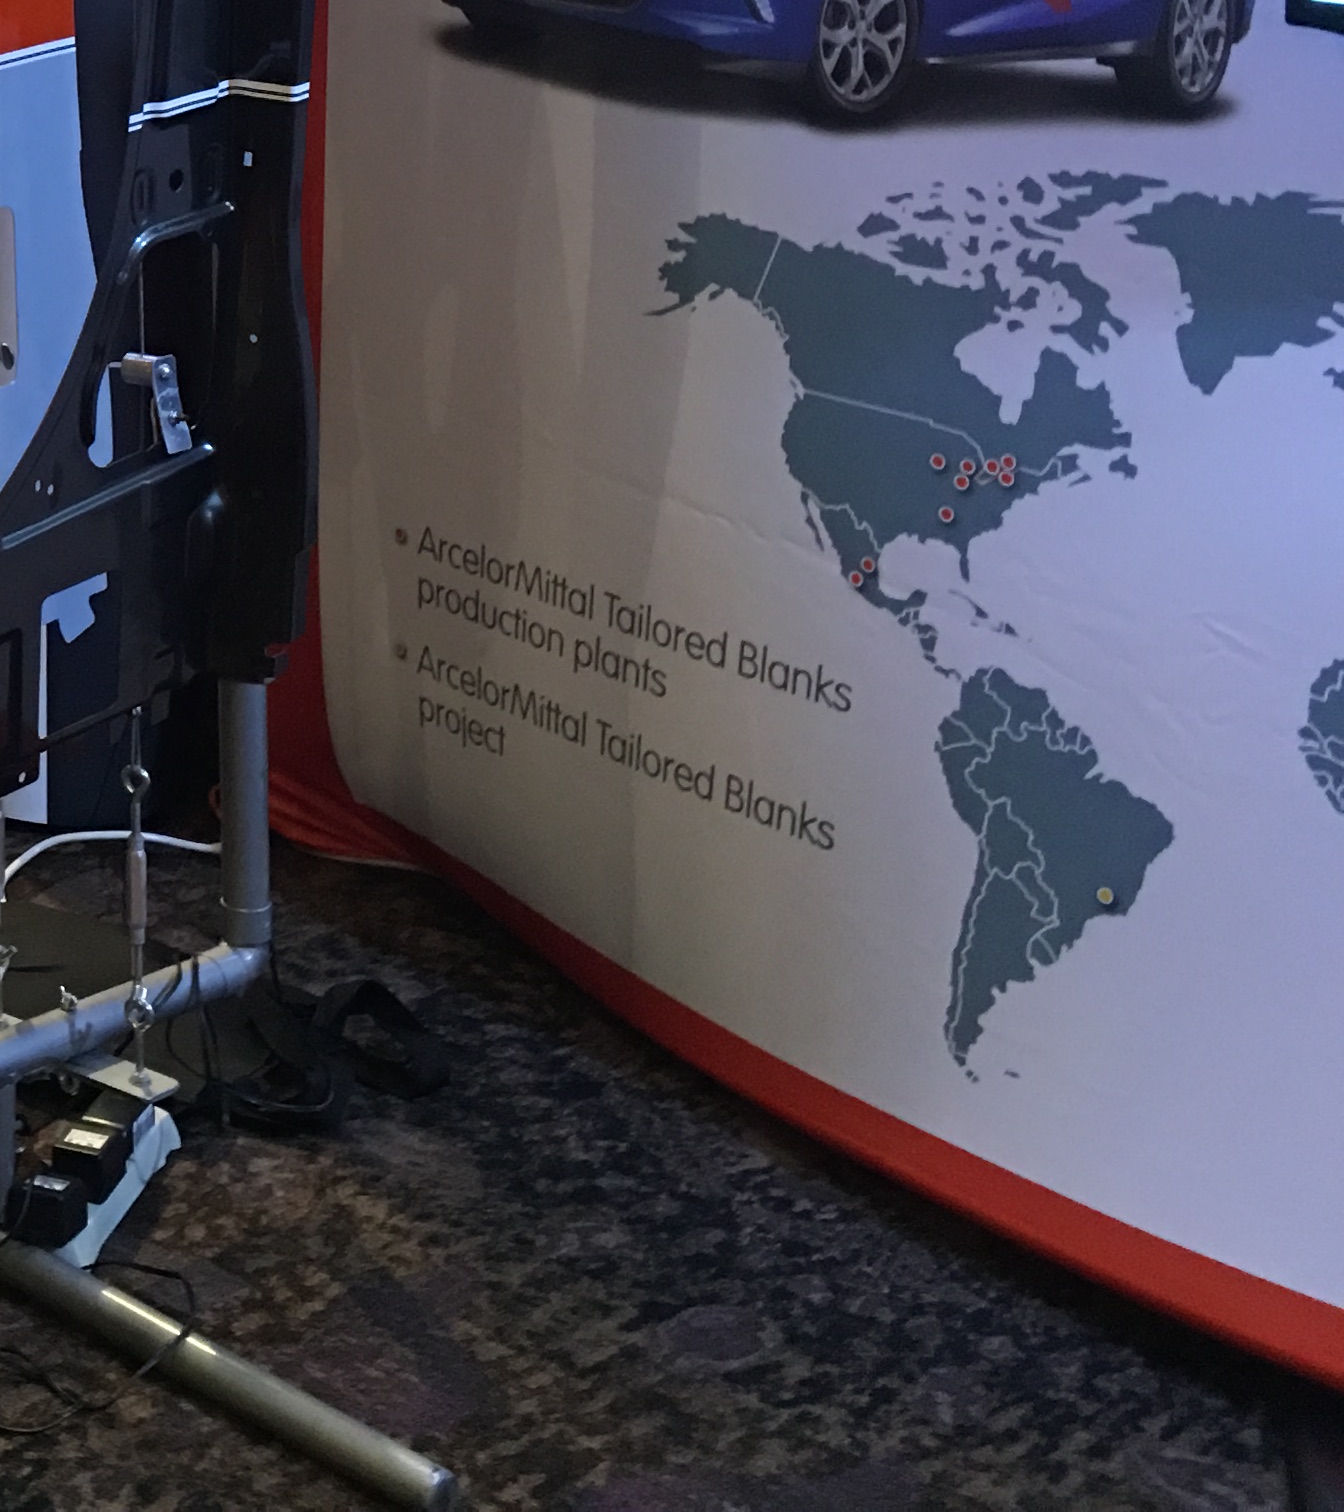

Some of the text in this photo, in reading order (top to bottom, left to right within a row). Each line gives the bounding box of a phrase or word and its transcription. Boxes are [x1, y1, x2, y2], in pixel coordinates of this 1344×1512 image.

[417, 525, 853, 713] ArcelorMittal Tailored Blanks
[417, 576, 668, 698] production plants
[416, 645, 836, 851] ArcelorMittal Tailored Blanks
[418, 696, 505, 756] project
